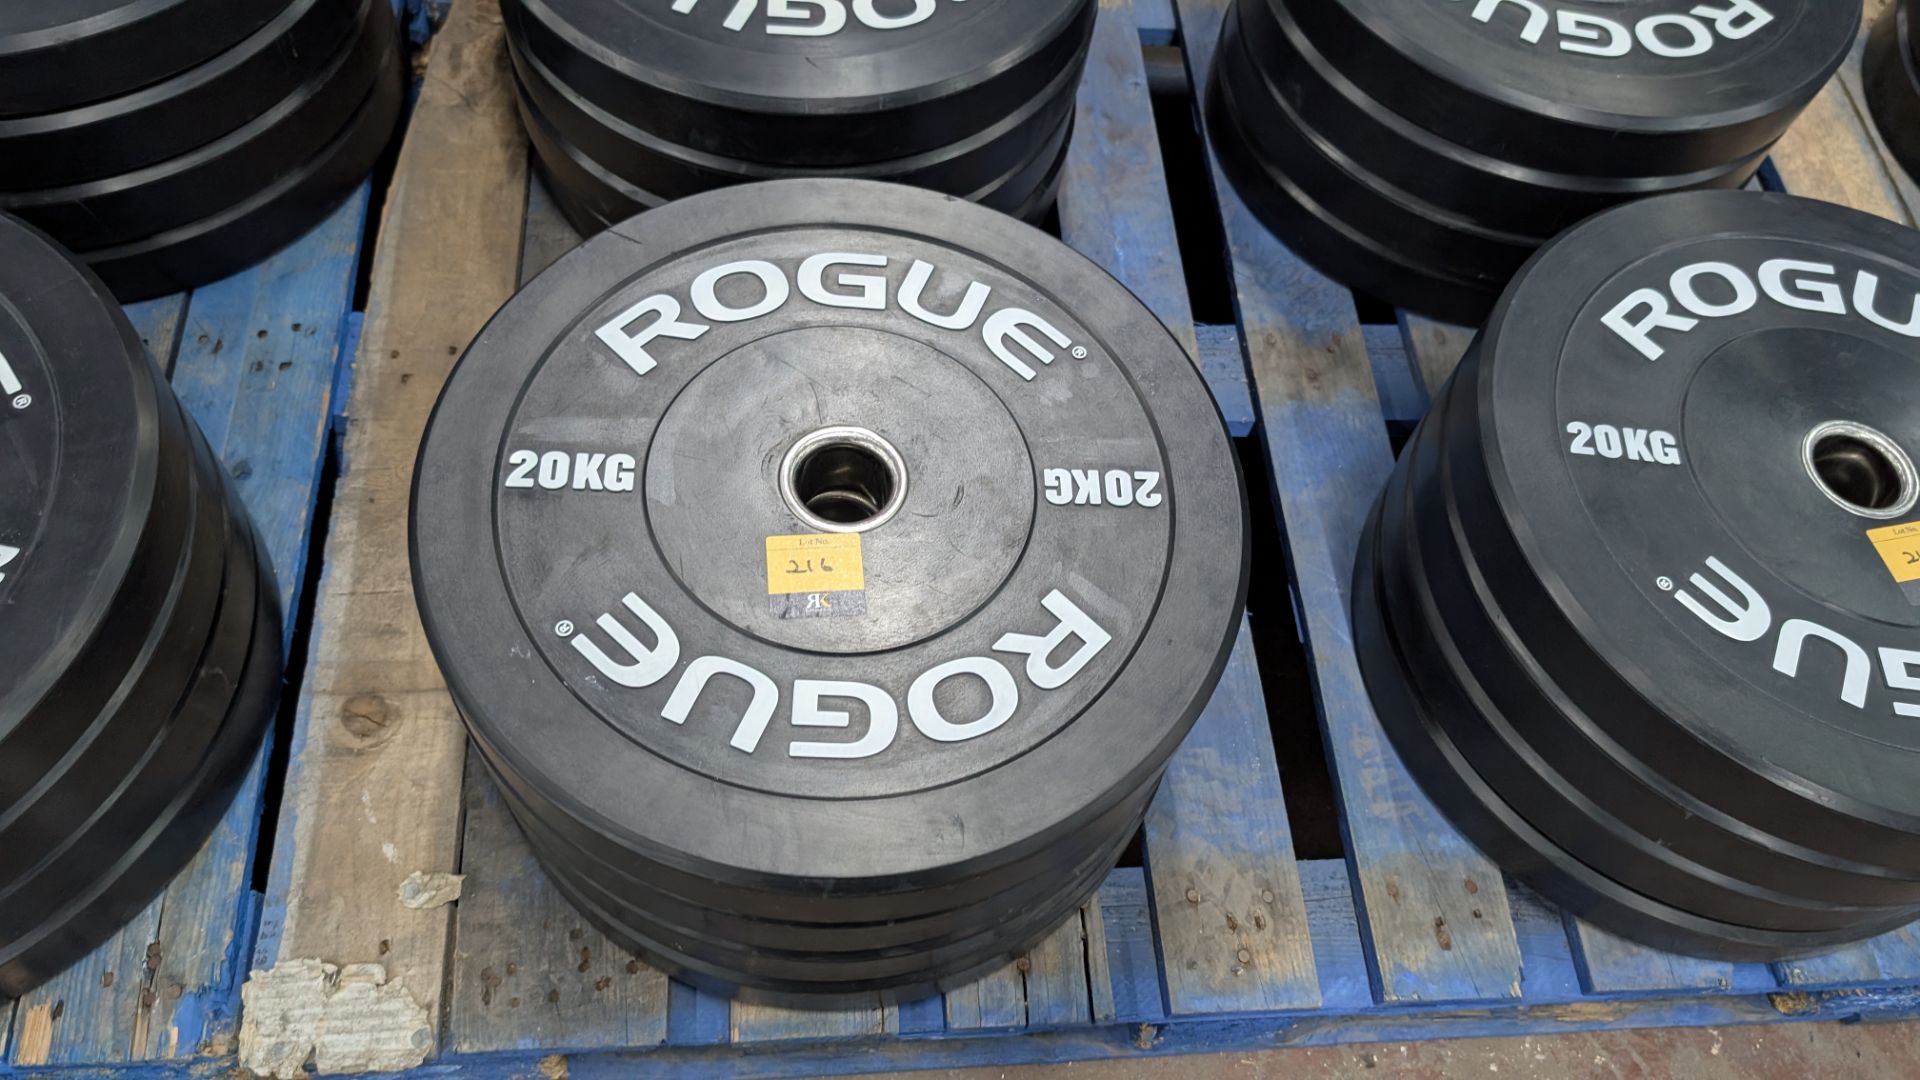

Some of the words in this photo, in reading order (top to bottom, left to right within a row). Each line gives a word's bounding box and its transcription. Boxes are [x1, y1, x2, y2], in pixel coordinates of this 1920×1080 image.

[1566, 421, 1681, 465] 20KG
[505, 449, 637, 491] 20KG
[1043, 467, 1163, 507] 20KG
[799, 538, 814, 546] Lot
[785, 558, 834, 573] 216
